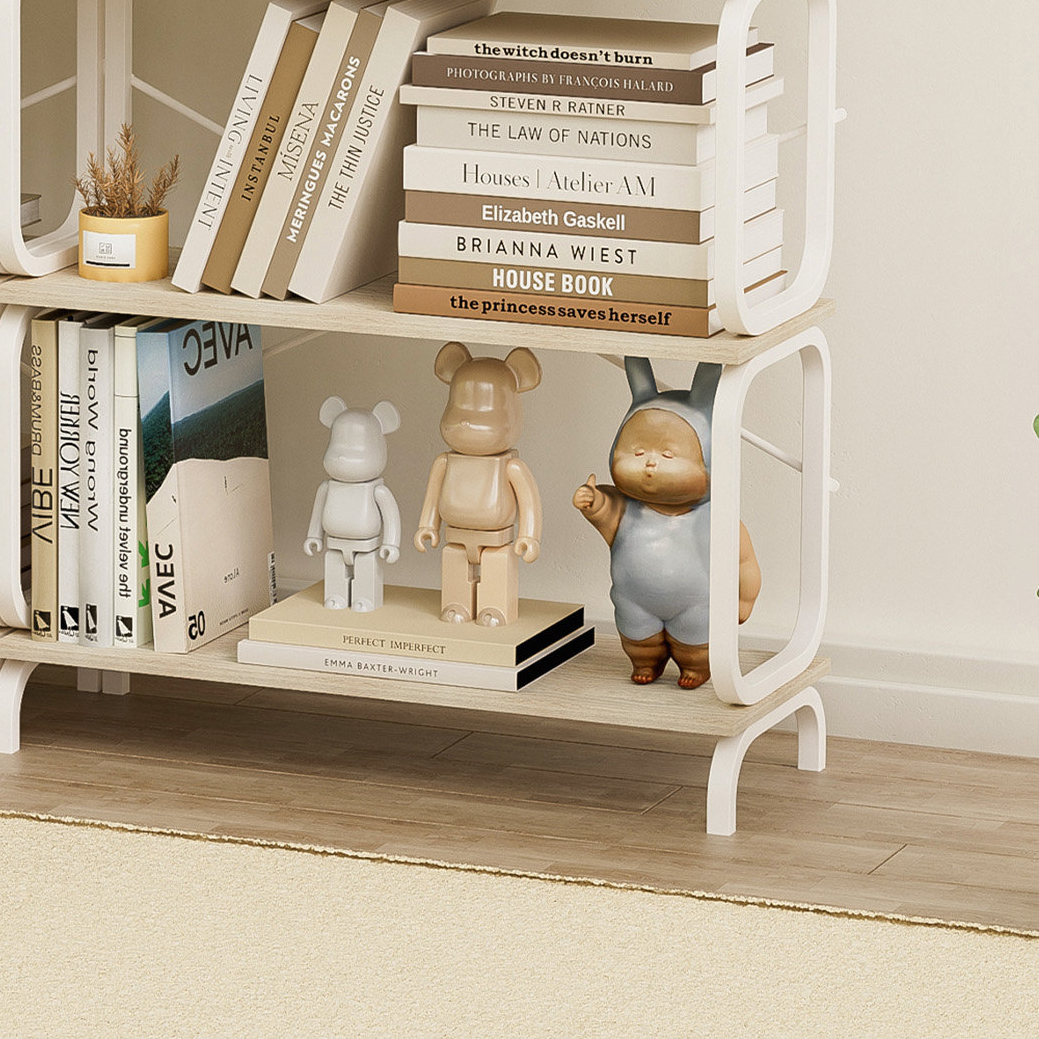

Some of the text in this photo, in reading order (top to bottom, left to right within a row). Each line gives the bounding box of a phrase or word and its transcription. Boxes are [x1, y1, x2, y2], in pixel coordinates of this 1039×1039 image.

[473, 42, 501, 56] the
[503, 44, 549, 59] witch
[614, 50, 654, 65] burn
[446, 67, 674, 93] PHOTOGRAPHS BY FRANÇOIS HALARD
[490, 95, 626, 117] STEVEN R RATNER
[286, 55, 361, 244] MERINGUES MACARONS
[328, 85, 385, 210] THE THIN JUSTICE
[467, 122, 652, 150] THE LAW OF NATIONS
[198, 74, 262, 230] LIVING INTENT
[241, 114, 280, 202] INSTANBUL
[482, 205, 626, 231] Elizabeth Gaskell
[493, 269, 614, 297] HOUSE BOOK
[342, 635, 446, 655] PERFECT IMPERFECT
[324, 658, 439, 678] EMMA BAXTER-WRIGHT
